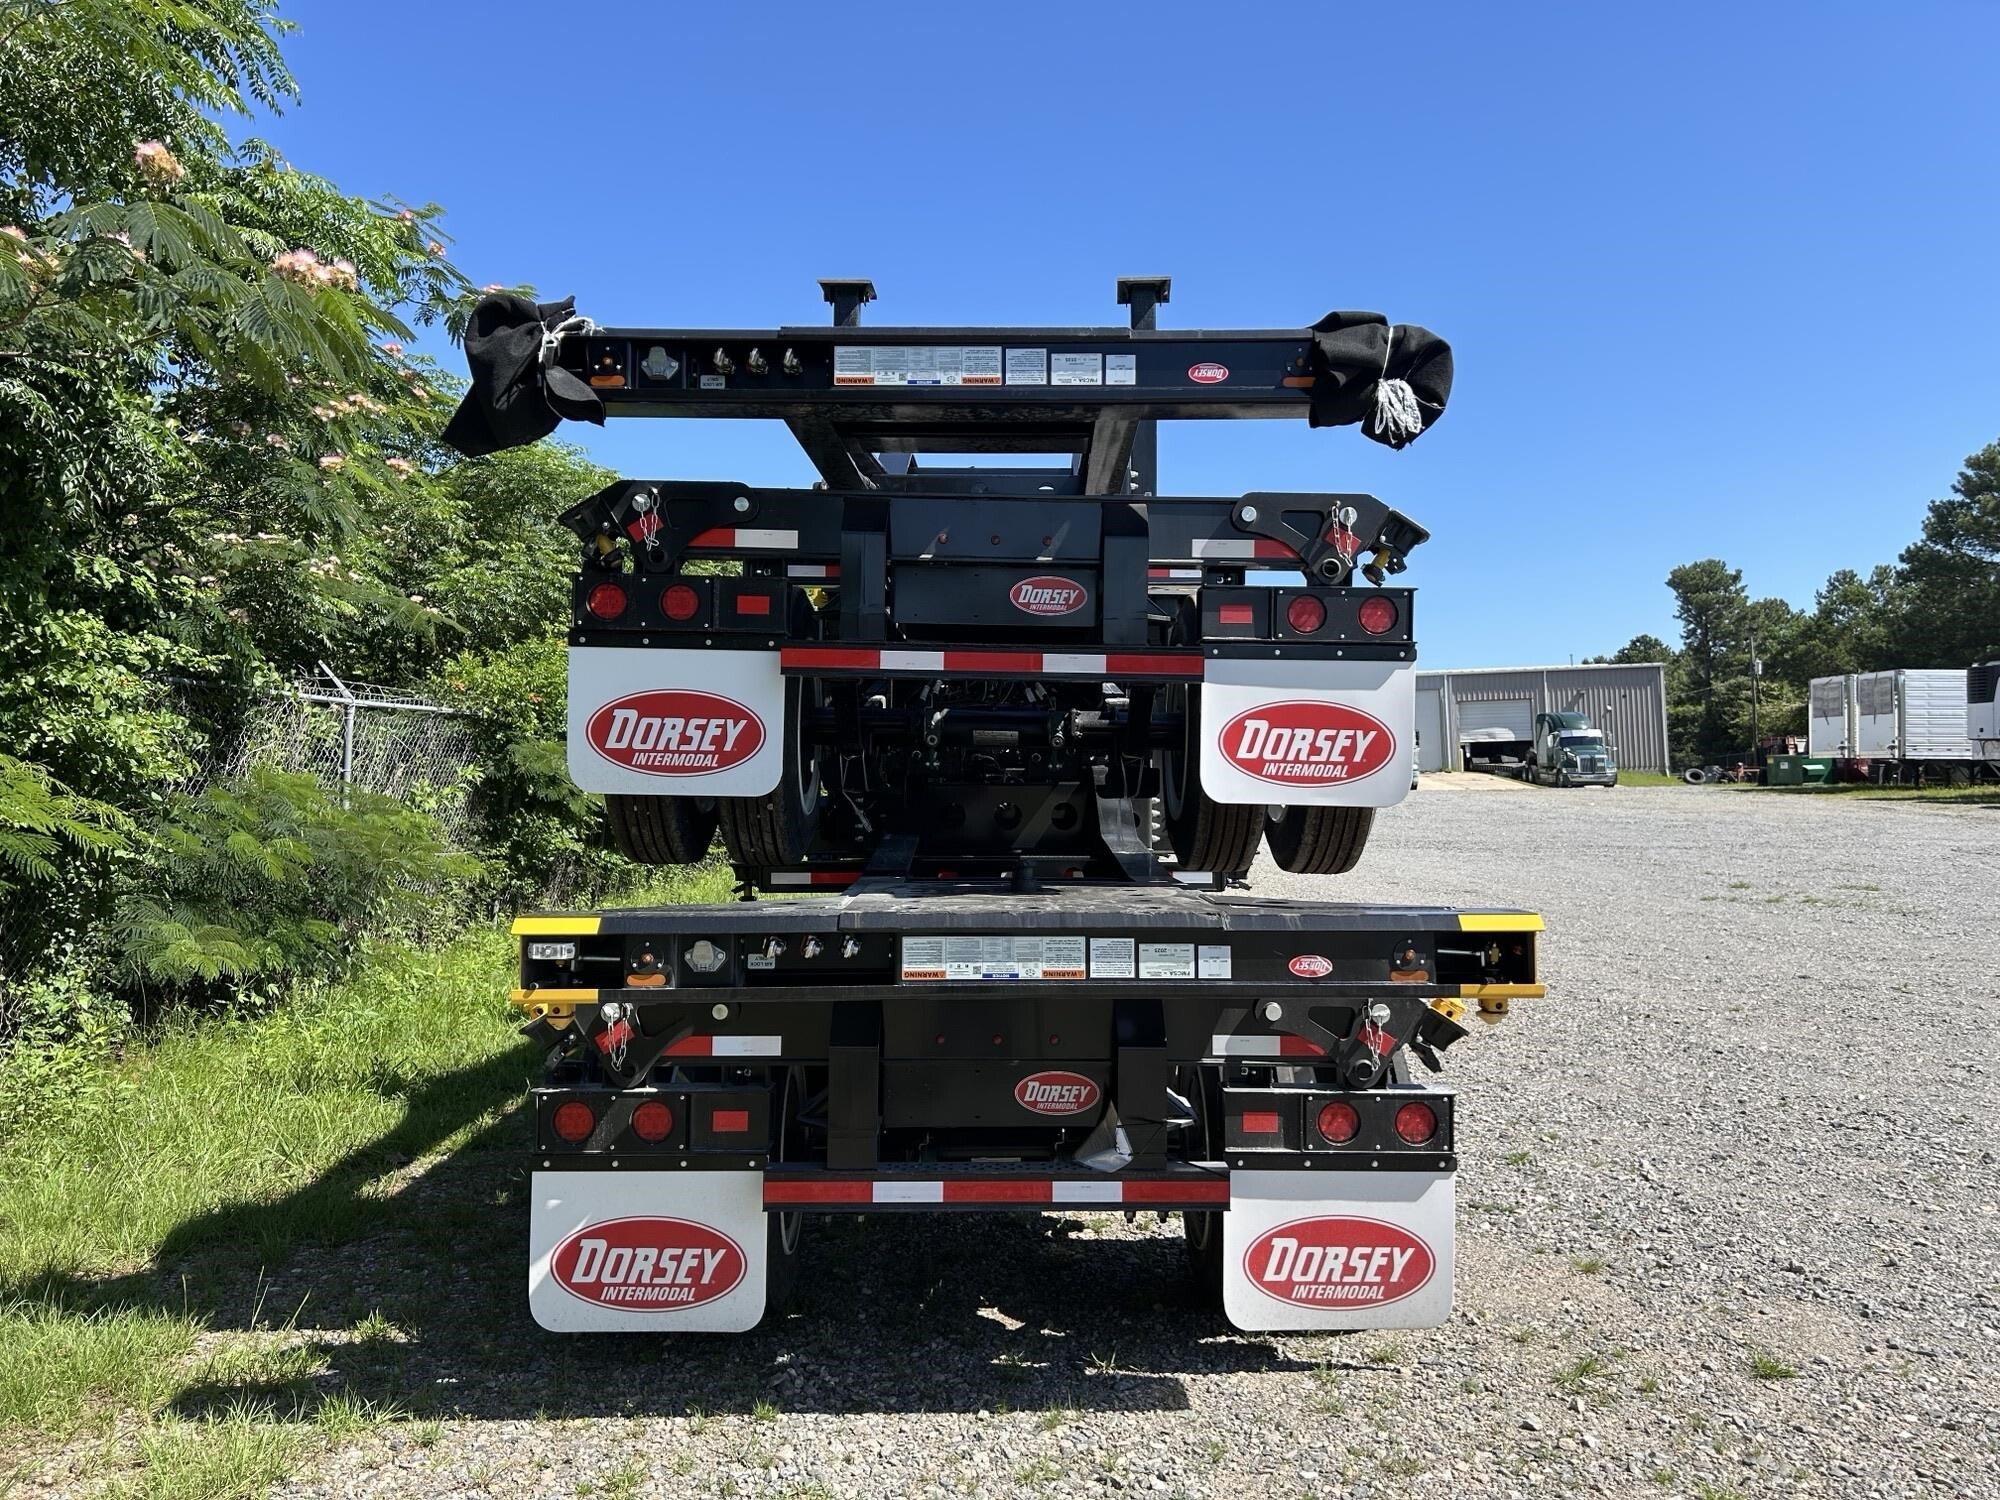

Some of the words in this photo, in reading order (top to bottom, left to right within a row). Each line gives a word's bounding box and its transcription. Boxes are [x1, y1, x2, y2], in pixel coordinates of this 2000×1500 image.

[1193, 368, 1224, 378] DORSEY
[1018, 584, 1079, 604] DORSEY
[604, 708, 749, 752] DORSEY
[1235, 719, 1379, 762] DORSEY
[632, 752, 719, 768] INTERMODAL
[1262, 762, 1349, 778] INTERMODAL
[1293, 961, 1327, 972] DORSEY
[1024, 1080, 1091, 1102] DORSEY
[1037, 1102, 1078, 1110] INTERMODAL
[570, 1238, 727, 1285] DORSEY
[1263, 1237, 1416, 1283] DORSEY
[600, 1285, 696, 1302] INTERMODAL
[1291, 1284, 1385, 1301] INTERMODAL
